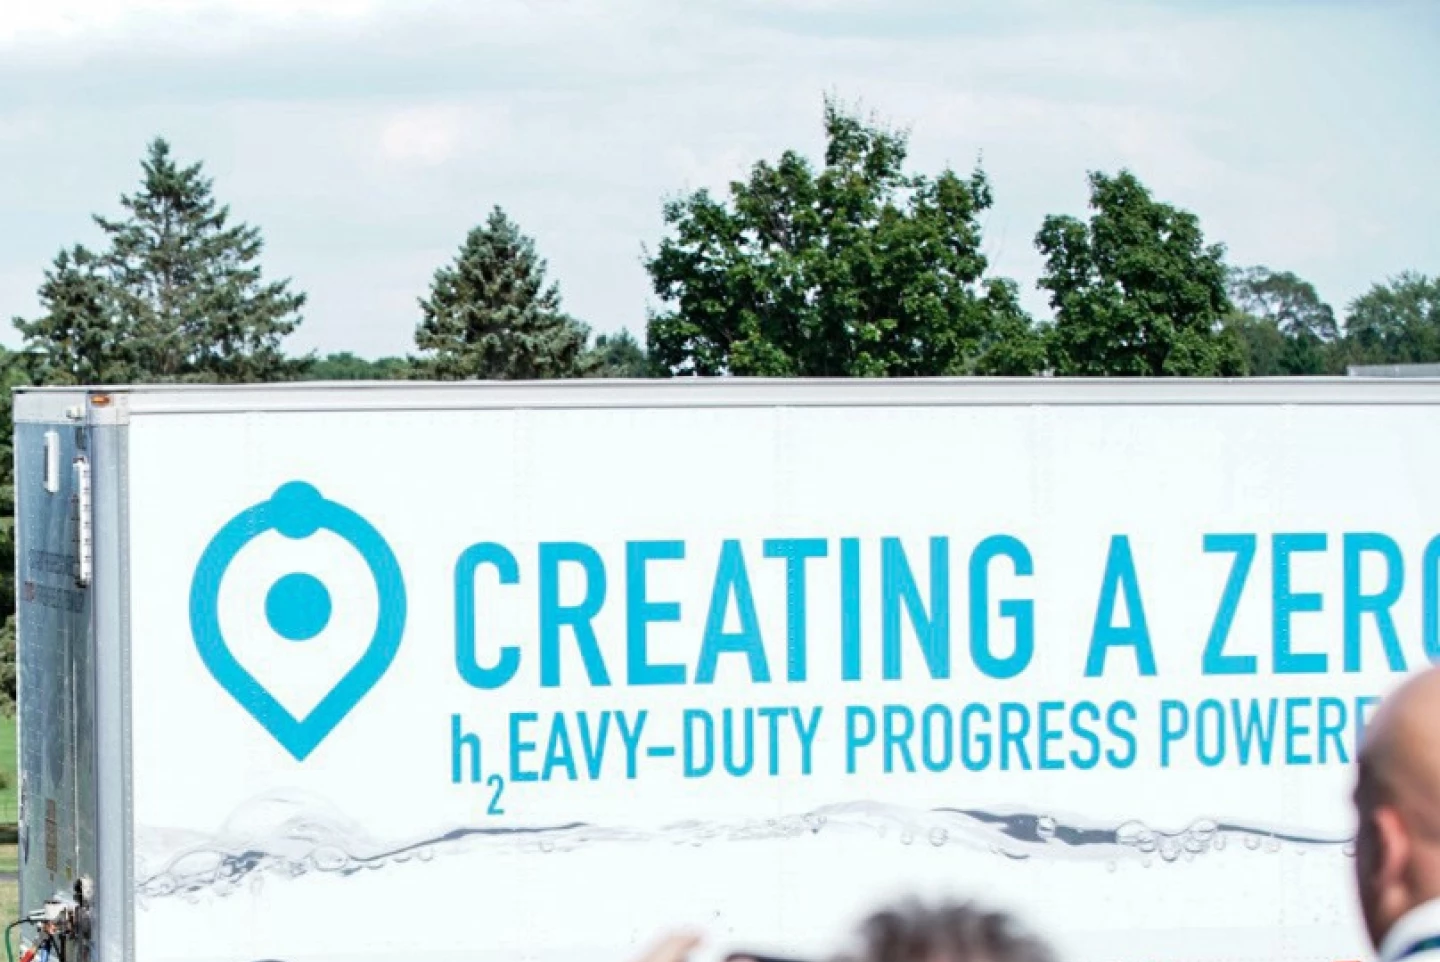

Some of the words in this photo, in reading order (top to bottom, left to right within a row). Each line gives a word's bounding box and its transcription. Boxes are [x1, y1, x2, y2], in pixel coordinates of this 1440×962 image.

[453, 532, 1037, 691] CREATING
[1084, 533, 1159, 680] A
[845, 698, 1139, 774] PROGRESS
